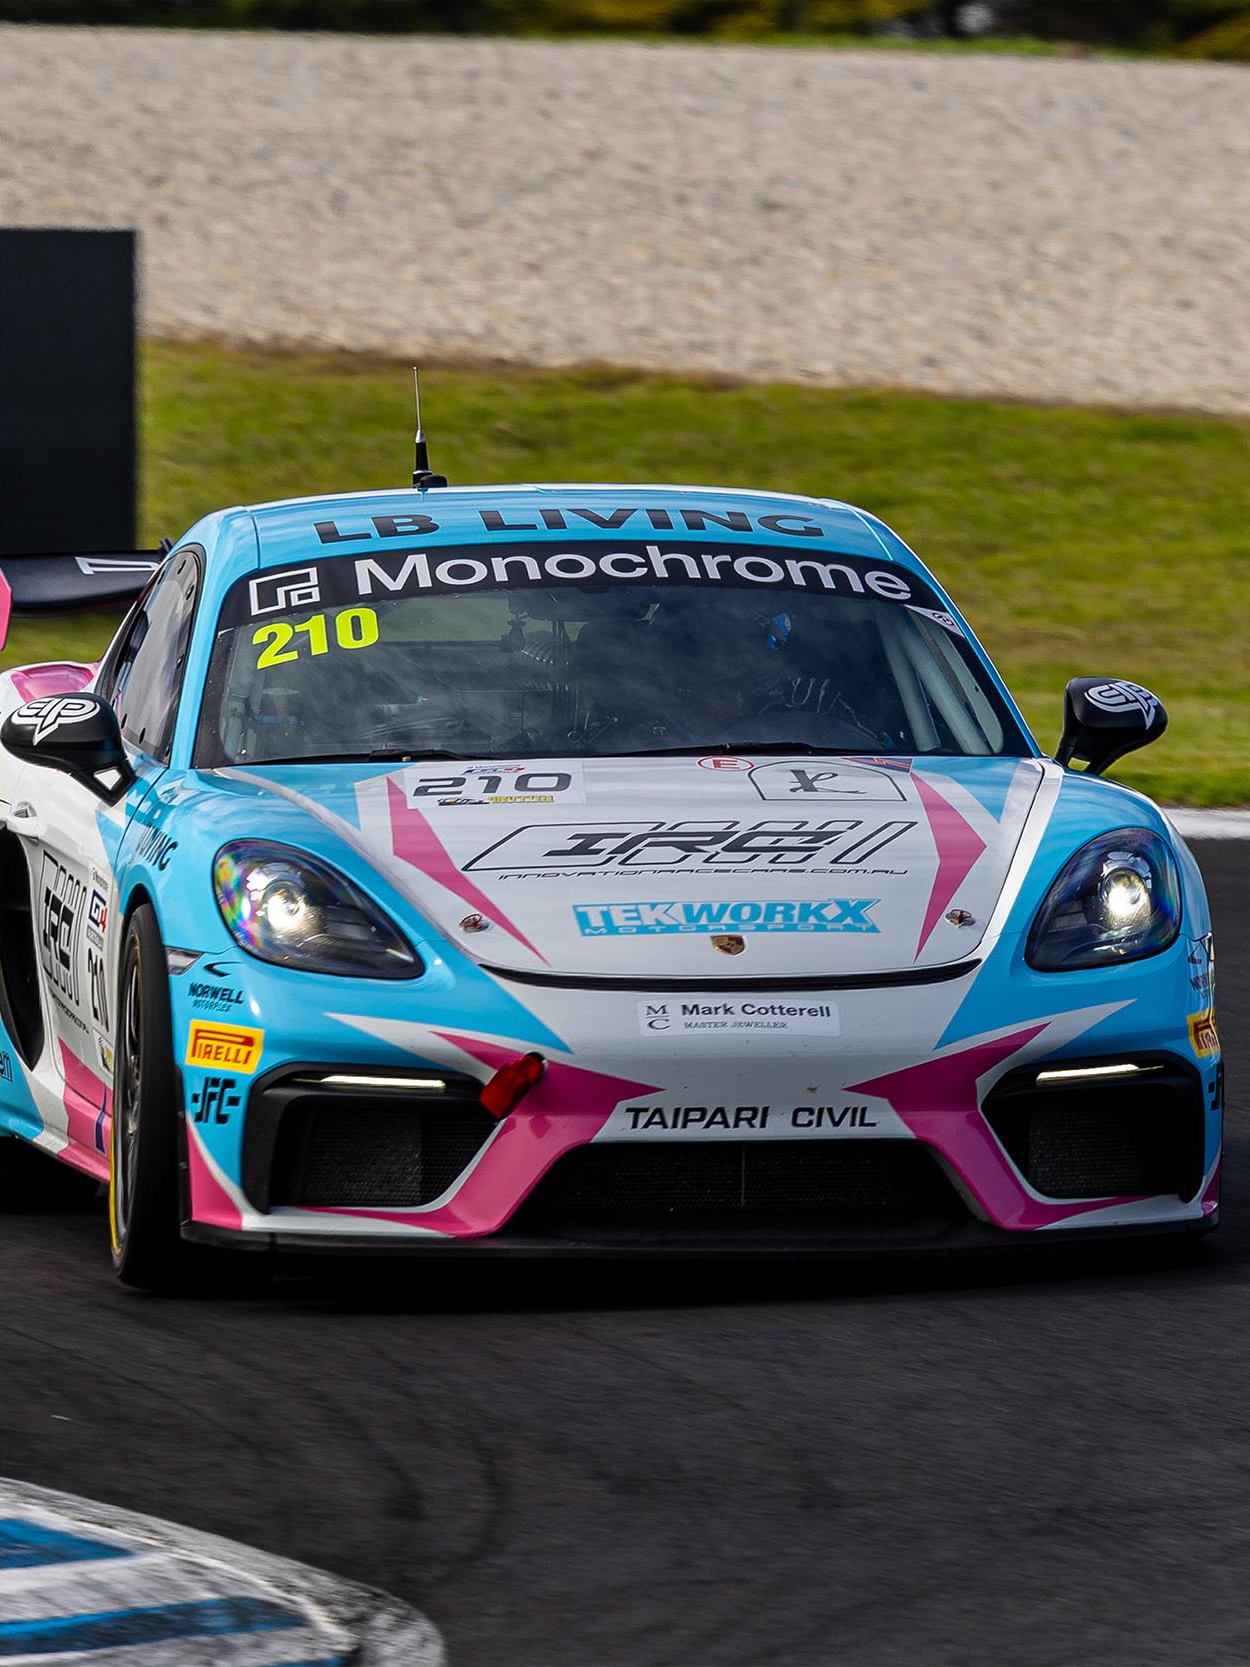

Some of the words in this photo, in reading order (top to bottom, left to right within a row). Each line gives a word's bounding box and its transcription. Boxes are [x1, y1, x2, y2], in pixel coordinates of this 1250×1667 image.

[313, 514, 440, 545] LB
[478, 507, 824, 537] LIVING
[354, 545, 912, 600] Monochrome
[252, 607, 380, 670] 210
[413, 772, 572, 797] 210
[584, 923, 879, 936] MOTORSPORT
[188, 982, 245, 1005] NORWELL
[681, 1003, 735, 1016] Mark
[741, 1003, 831, 1017] Cotterell
[191, 1029, 255, 1065] PIRELLI
[624, 1105, 770, 1130] TAIPARI
[791, 1106, 880, 1129] CIVIL
